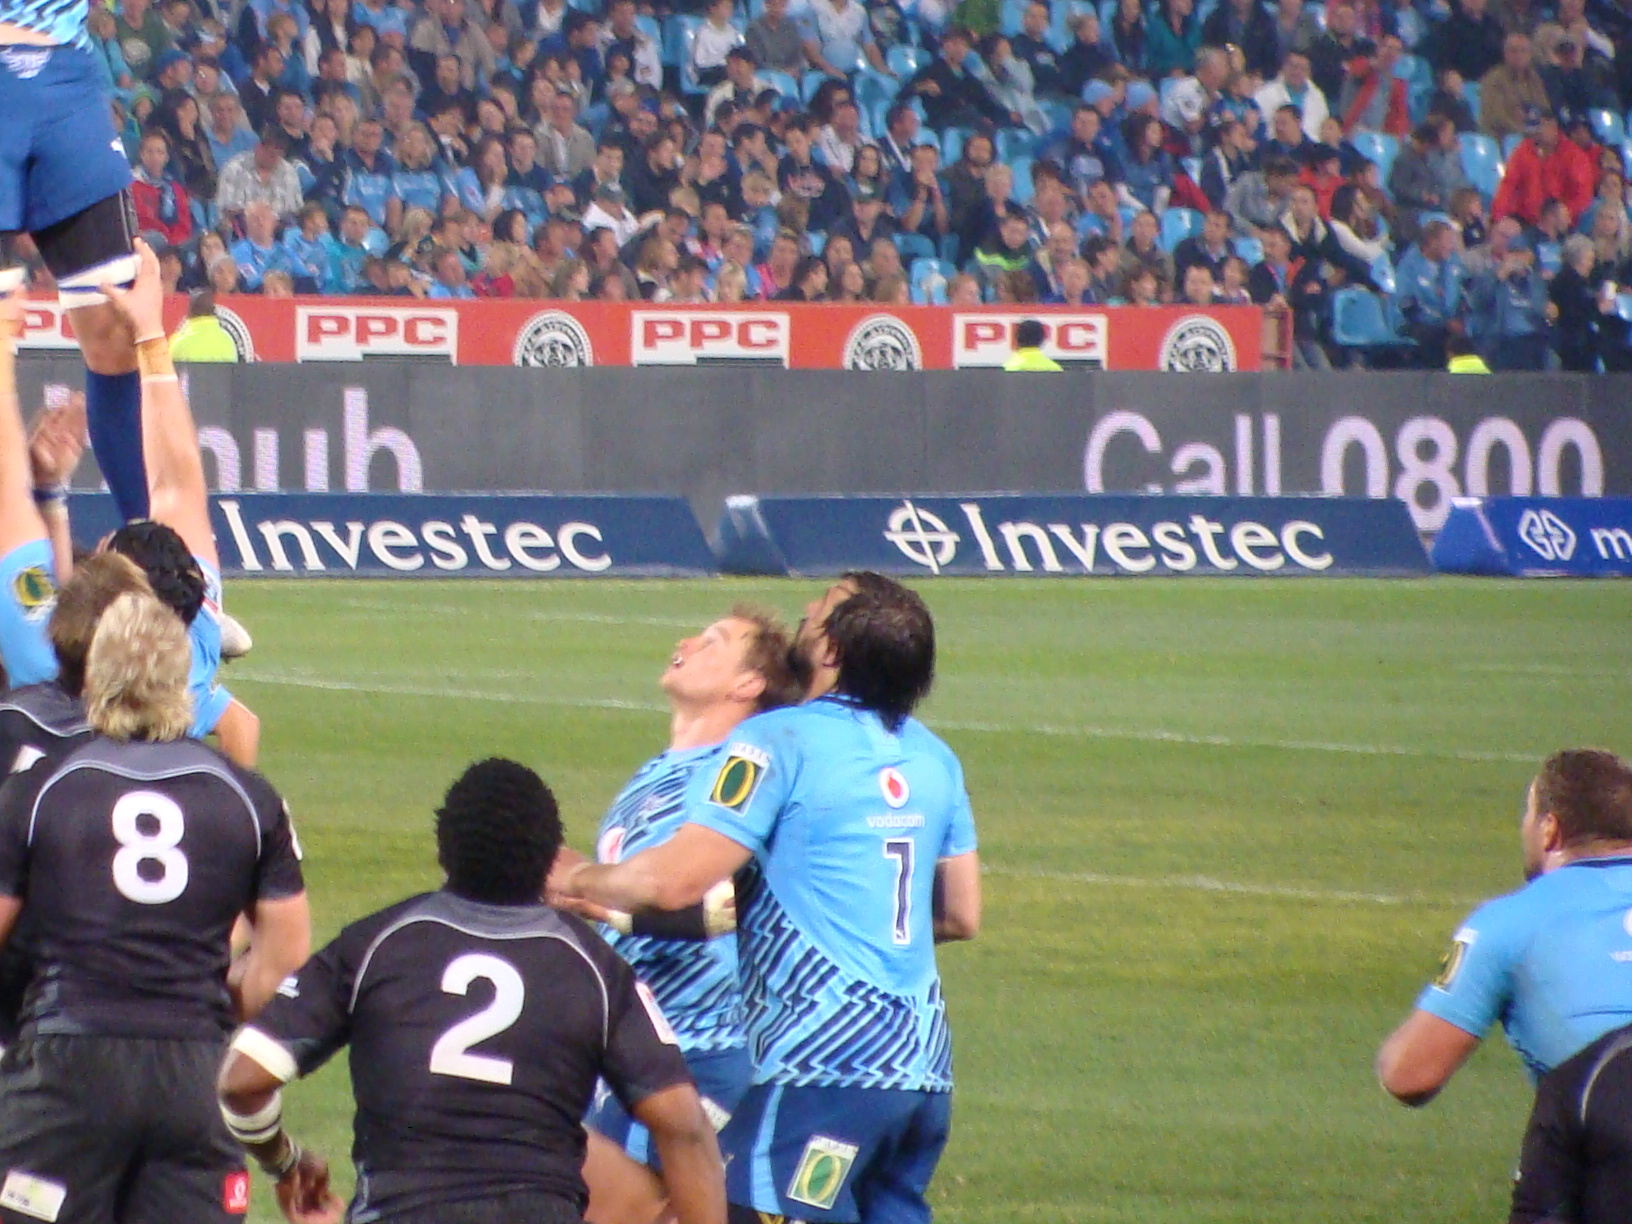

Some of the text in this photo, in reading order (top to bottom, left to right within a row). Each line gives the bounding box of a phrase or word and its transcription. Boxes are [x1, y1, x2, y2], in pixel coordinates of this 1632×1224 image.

[306, 315, 449, 345] PPC
[642, 319, 781, 352] PPC
[1083, 410, 1603, 532] Call 0800
[218, 498, 614, 573] Investec
[960, 502, 1334, 573] Investec
[111, 790, 190, 905] 8
[865, 812, 926, 828] vodacom
[882, 837, 915, 946] 1
[428, 953, 526, 1086] 2
